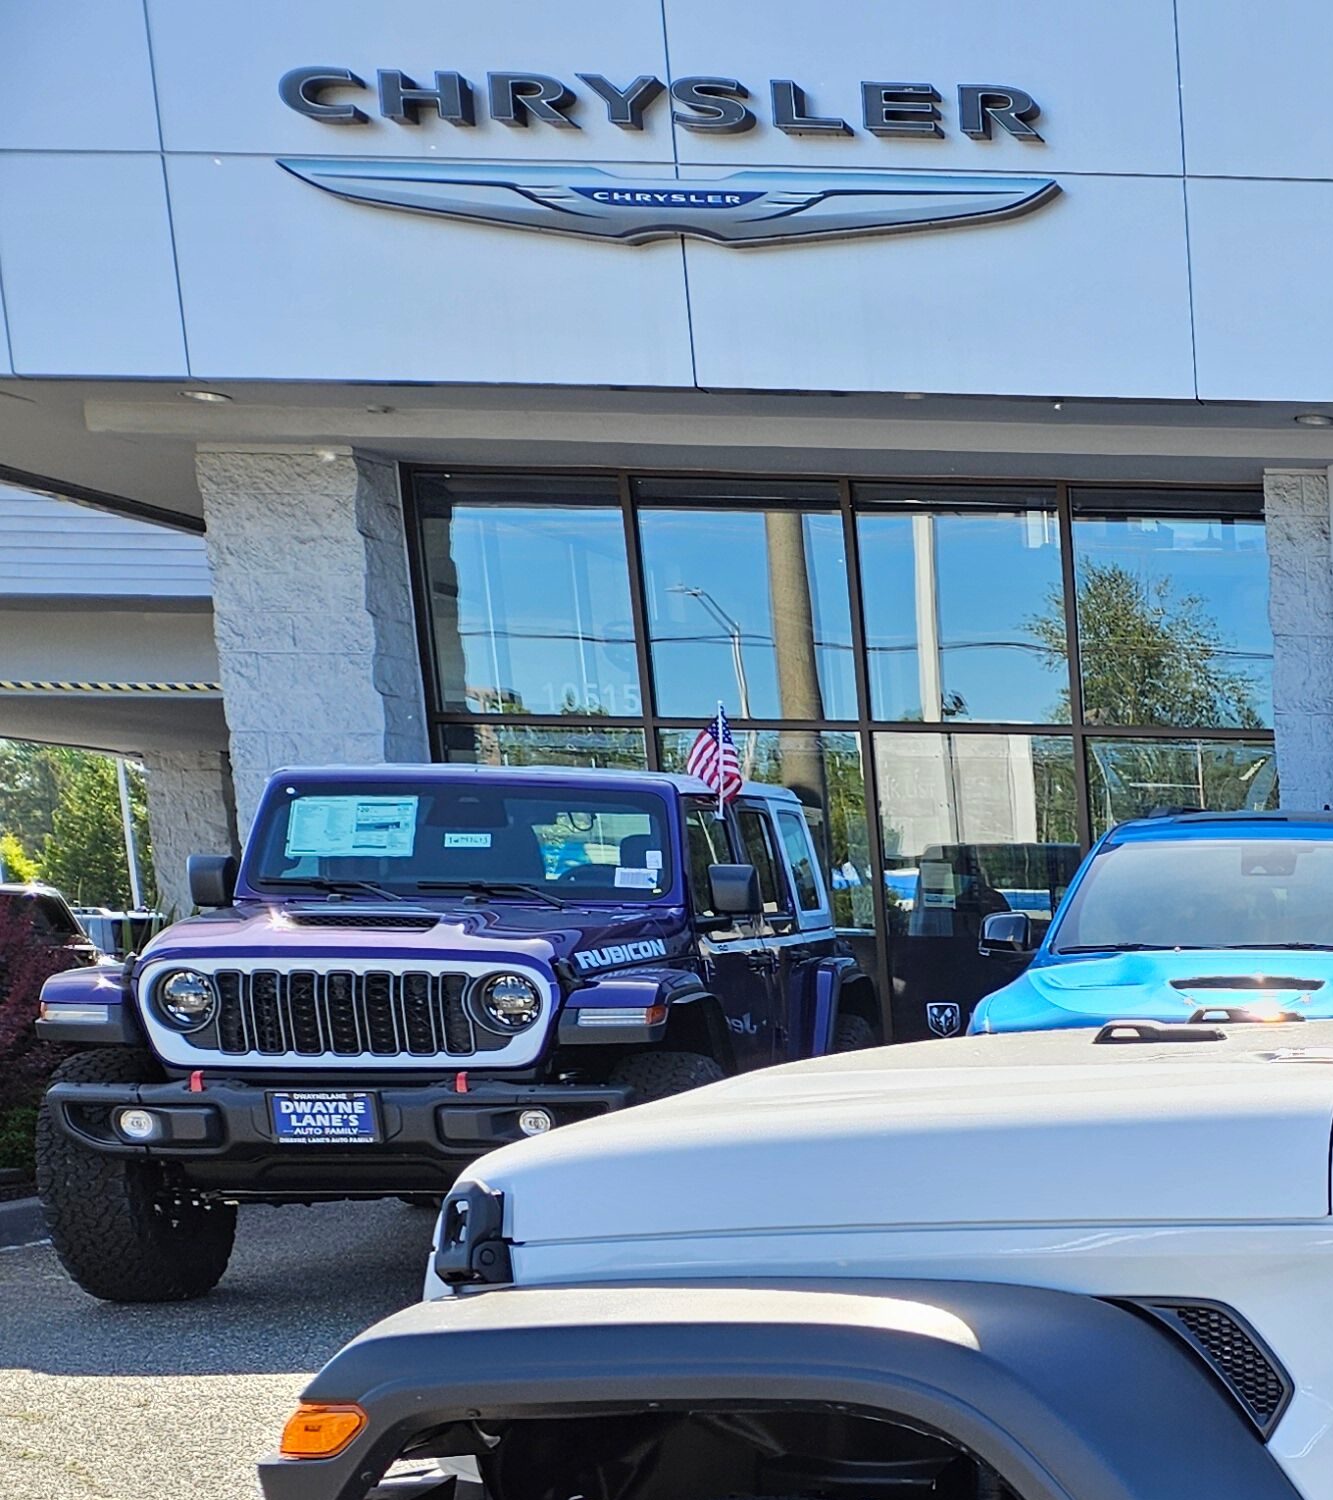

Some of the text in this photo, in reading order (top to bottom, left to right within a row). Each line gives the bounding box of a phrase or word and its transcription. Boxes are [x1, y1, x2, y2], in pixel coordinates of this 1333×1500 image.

[278, 65, 1046, 143] CHRYSLER
[593, 191, 741, 204] CHRYSLER
[573, 938, 668, 970] RUBICON
[280, 1101, 367, 1114] DWAYNE
[290, 1114, 360, 1127] LANE'S
[293, 1127, 359, 1135] AUTO FAMILY
